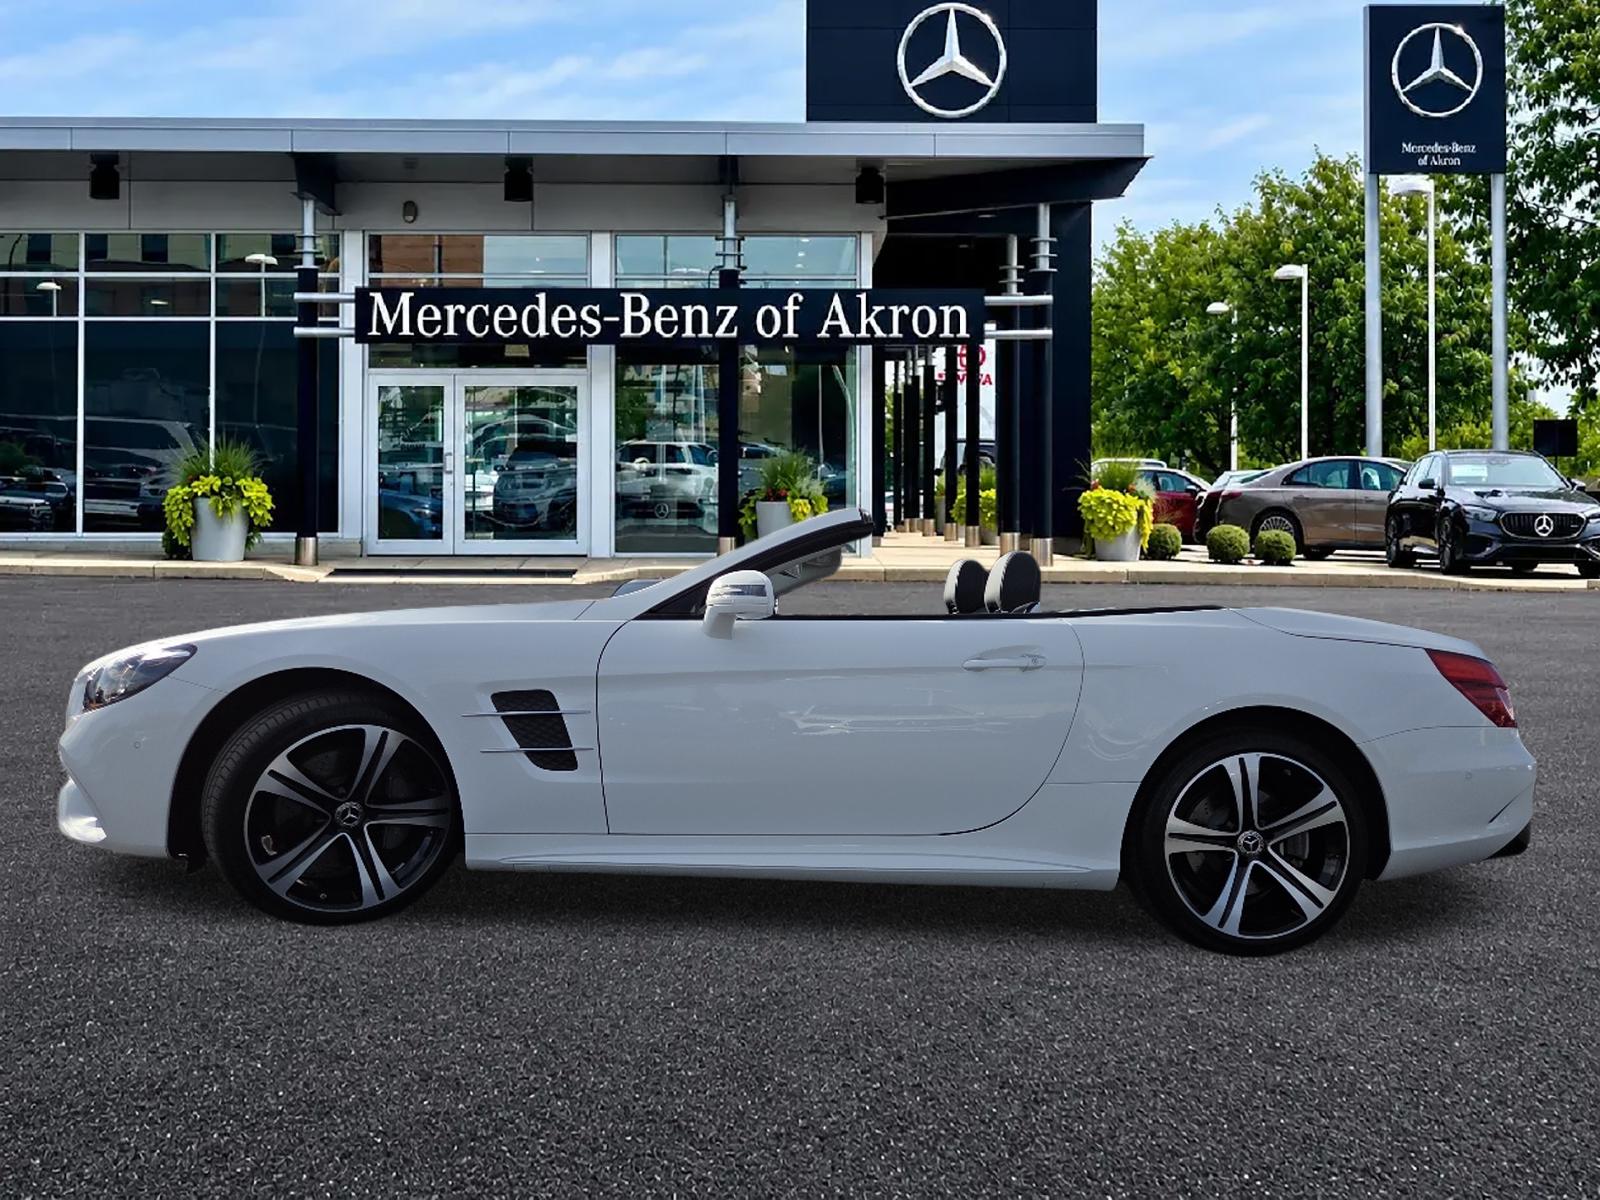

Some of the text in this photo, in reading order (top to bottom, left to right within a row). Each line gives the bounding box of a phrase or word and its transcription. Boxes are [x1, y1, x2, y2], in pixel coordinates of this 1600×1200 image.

[1401, 141, 1477, 154] Mercedes-Benz
[1417, 154, 1461, 166] of Akron
[367, 292, 970, 338] Mercedes-Benz of Akron
